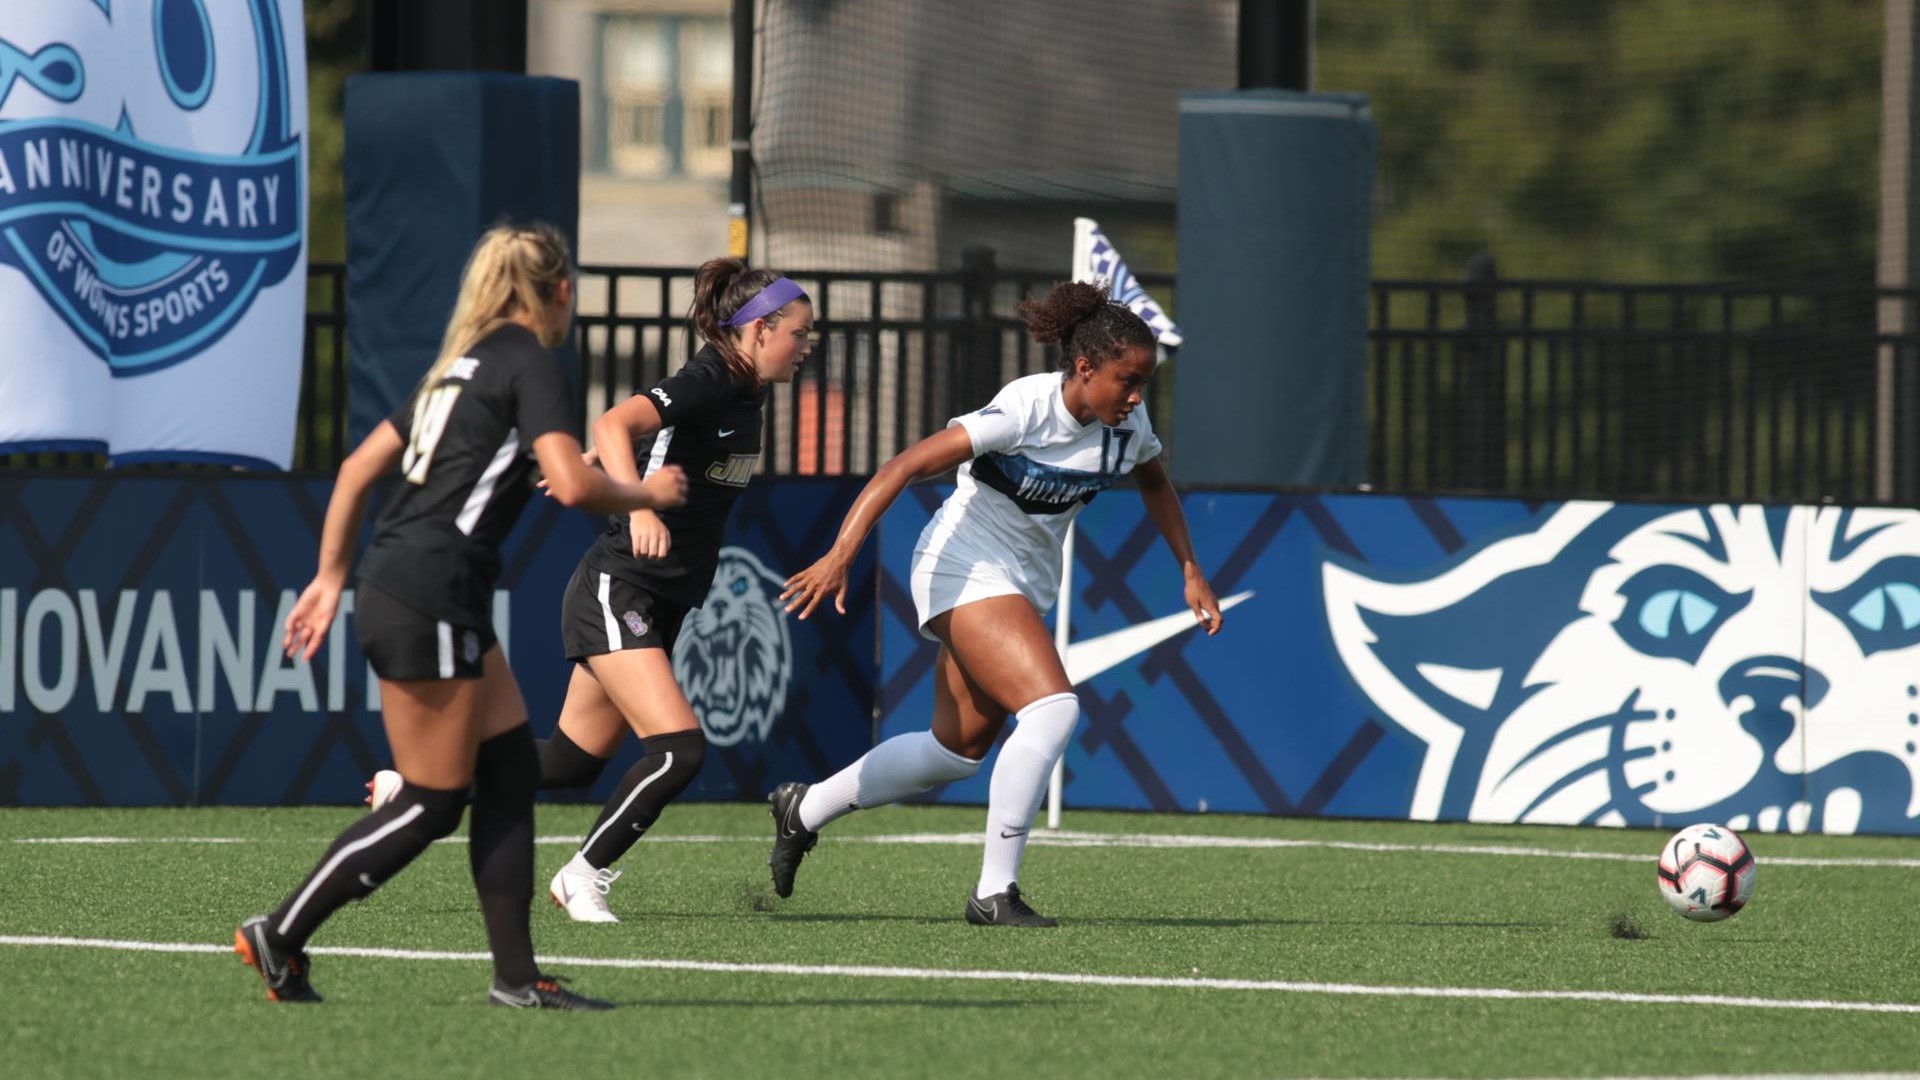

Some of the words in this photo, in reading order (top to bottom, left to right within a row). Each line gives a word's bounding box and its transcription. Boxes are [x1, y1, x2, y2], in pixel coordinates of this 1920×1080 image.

[47, 230, 77, 273] OF
[133, 259, 229, 338] SPORTS
[1102, 427, 1135, 474] 17
